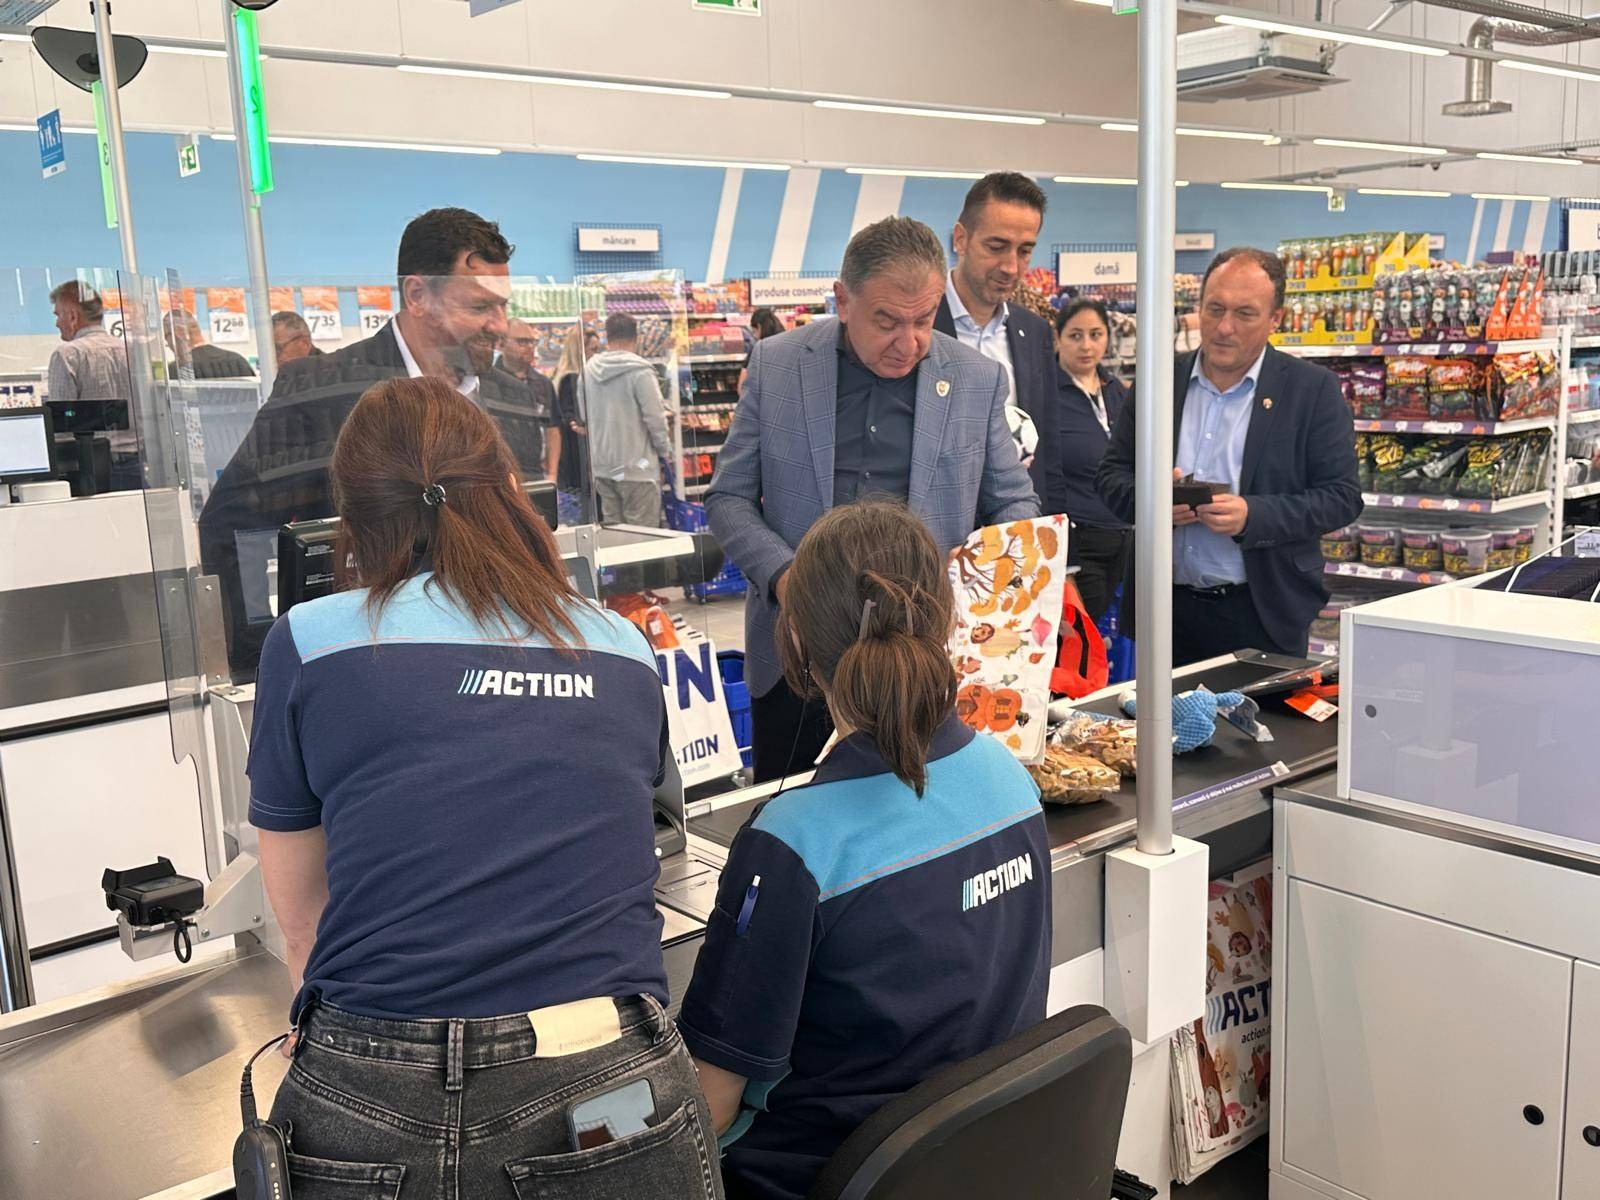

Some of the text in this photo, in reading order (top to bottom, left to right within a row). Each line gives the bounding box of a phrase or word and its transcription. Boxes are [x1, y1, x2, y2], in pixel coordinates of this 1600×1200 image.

[1094, 261, 1120, 275] damă
[754, 282, 790, 299] produse
[477, 669, 595, 698] ACTION
[677, 734, 719, 765] TION
[973, 852, 1033, 907] ACTION
[1221, 980, 1271, 1031] ACT
